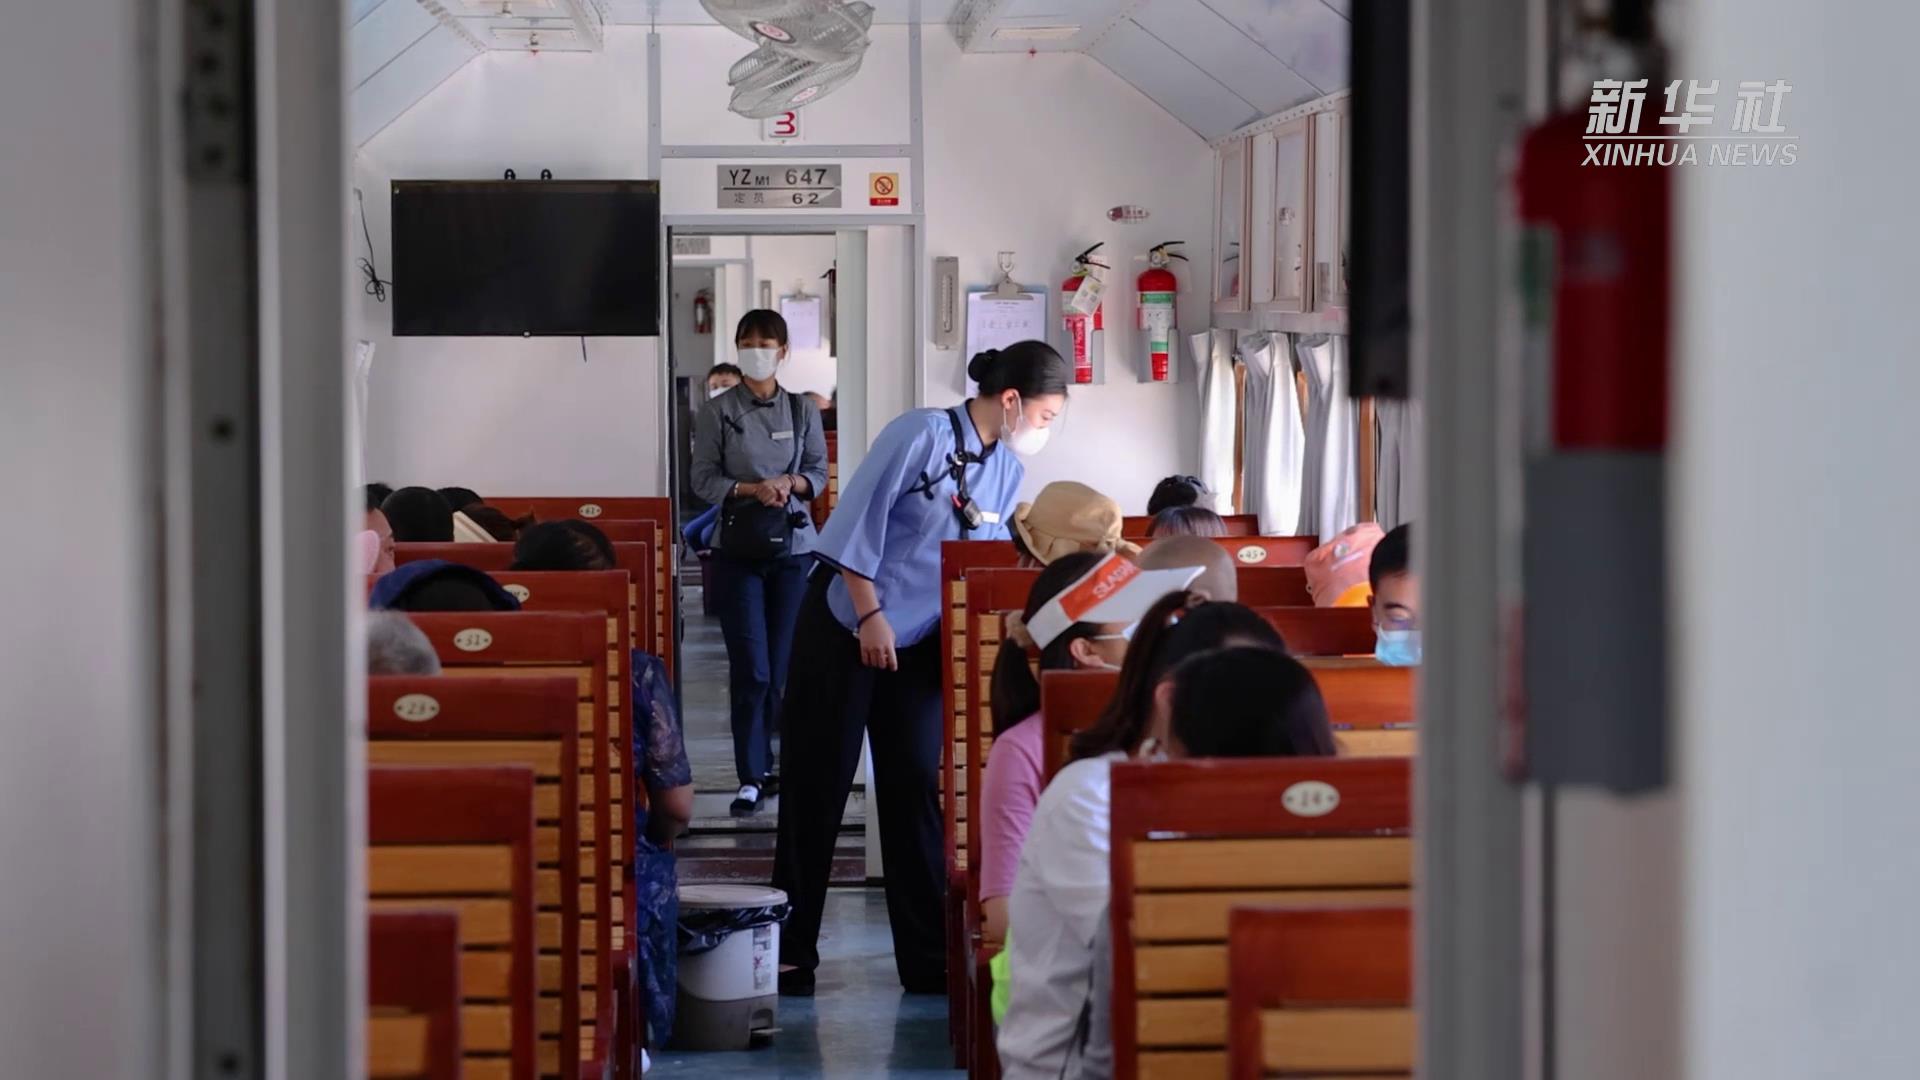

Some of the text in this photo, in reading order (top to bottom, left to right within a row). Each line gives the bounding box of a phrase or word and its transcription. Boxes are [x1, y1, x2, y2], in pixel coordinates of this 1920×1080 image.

[774, 111, 795, 134] 3
[785, 168, 827, 185] 647
[792, 192, 820, 205] 62
